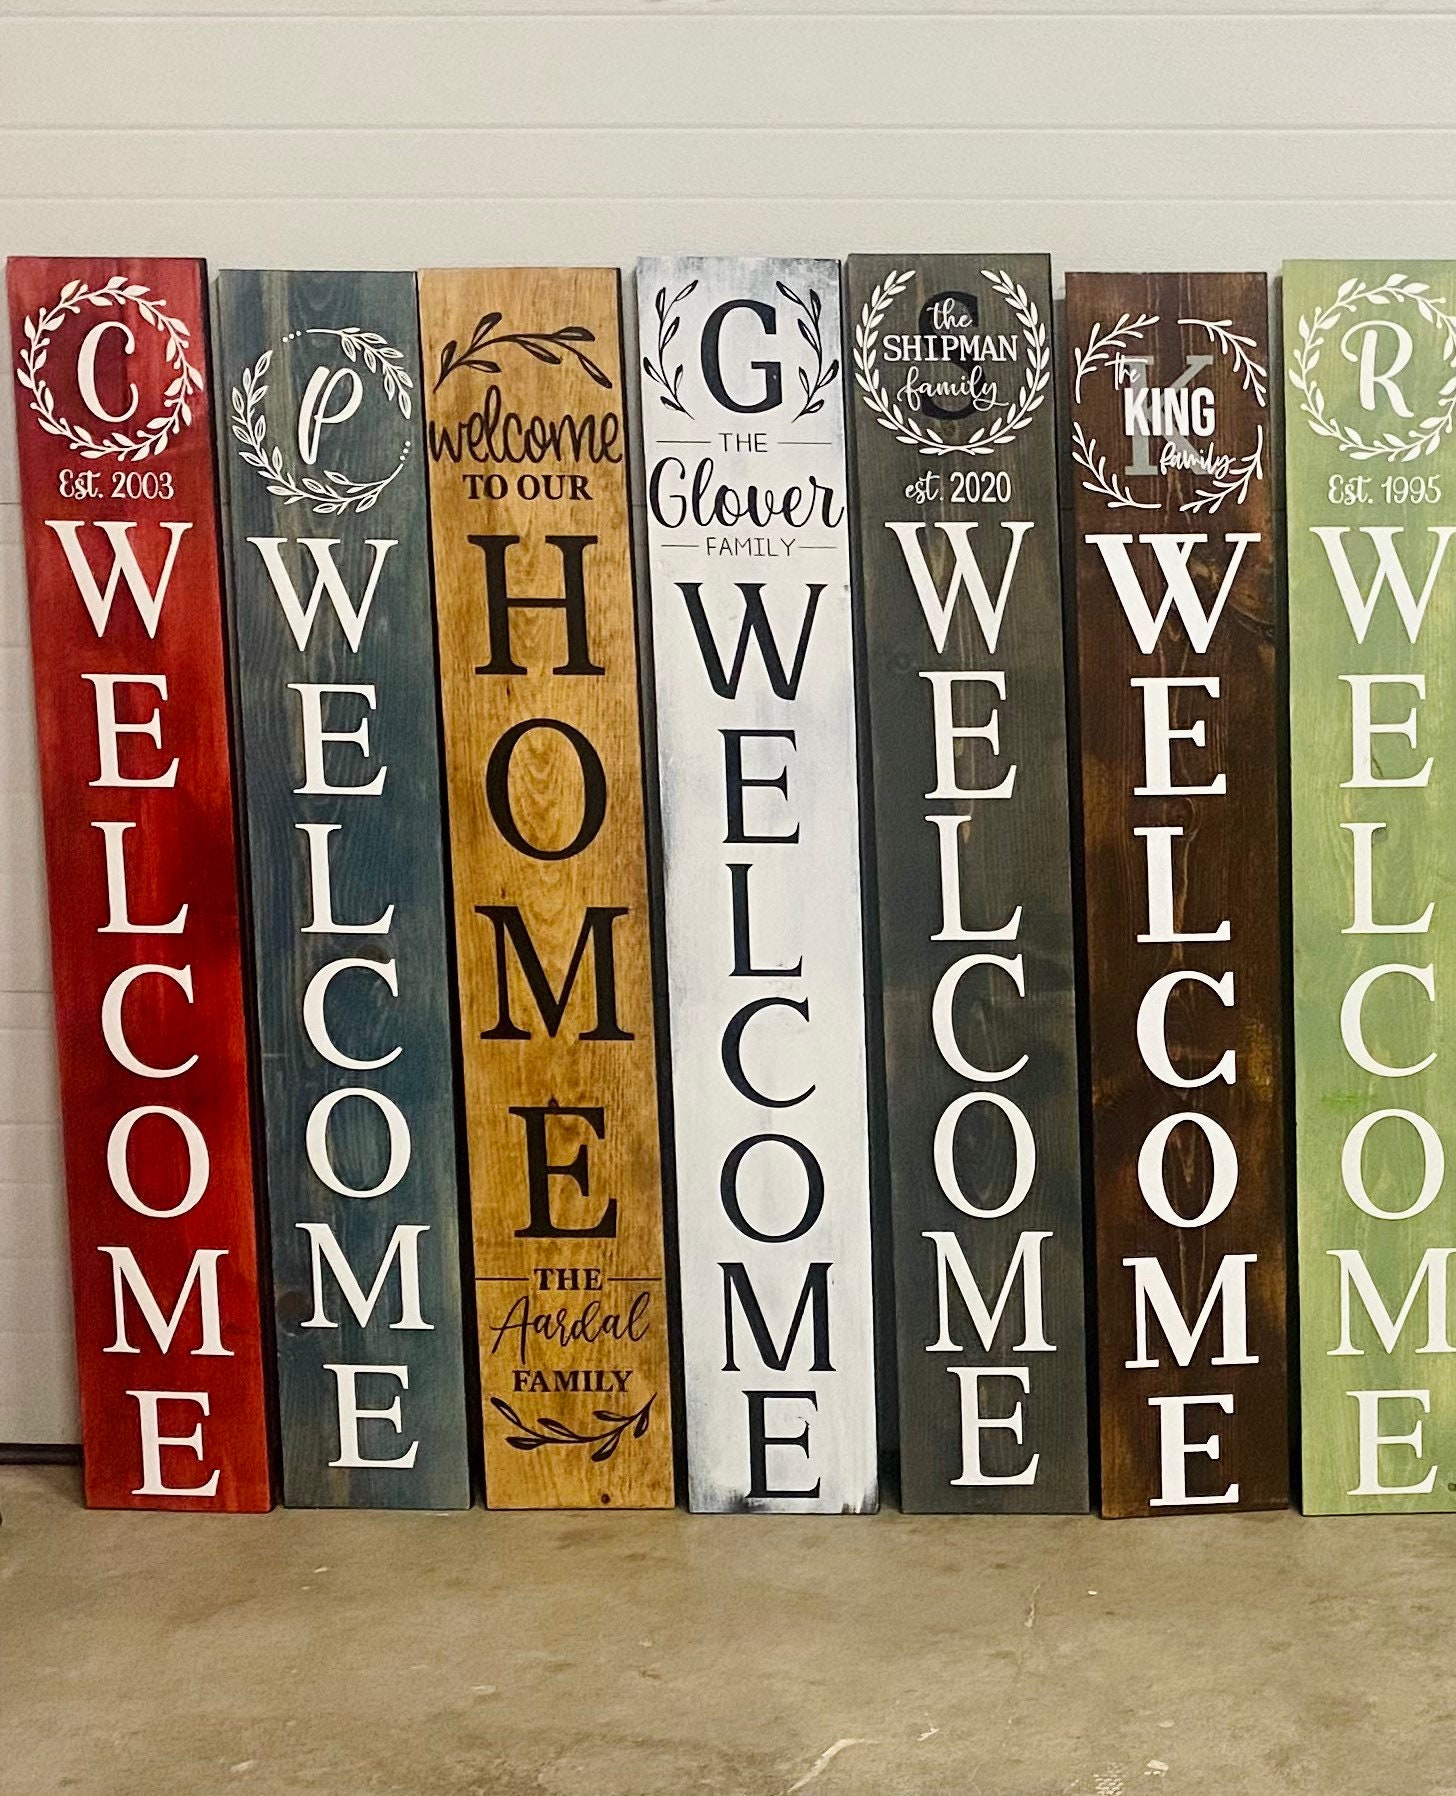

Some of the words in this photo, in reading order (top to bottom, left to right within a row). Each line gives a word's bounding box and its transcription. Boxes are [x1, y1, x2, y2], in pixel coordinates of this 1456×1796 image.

[926, 298, 973, 331] the
[77, 321, 139, 423] C
[700, 299, 783, 413] G
[883, 335, 1018, 362] SHIPMAN
[1104, 352, 1148, 390] the
[1340, 320, 1414, 418] R
[897, 366, 1009, 411] family
[1124, 387, 1215, 436] KING
[298, 366, 363, 465] P
[429, 385, 622, 463] welcome
[718, 432, 768, 452] THE
[1160, 442, 1236, 479] family
[59, 471, 103, 500] Est.
[111, 472, 174, 500] 2003
[463, 474, 508, 500] TO
[517, 474, 593, 500] OUR
[649, 457, 844, 528] Glover
[905, 470, 943, 505] est.
[950, 471, 1012, 503] 2020
[1328, 474, 1373, 505] Est.
[1381, 474, 1442, 504] 1995
[706, 537, 796, 557] FAMILY
[468, 534, 634, 1239] HOME
[45, 521, 233, 1497] WELCOME
[248, 538, 435, 1469] WELCOME
[884, 521, 1057, 1486] WELCOME
[1085, 533, 1260, 1507] WELCOME
[674, 583, 837, 1500] WELCOME
[534, 1268, 603, 1291] THE
[490, 1292, 650, 1364] Aardal
[512, 1370, 633, 1393] FAMILY
